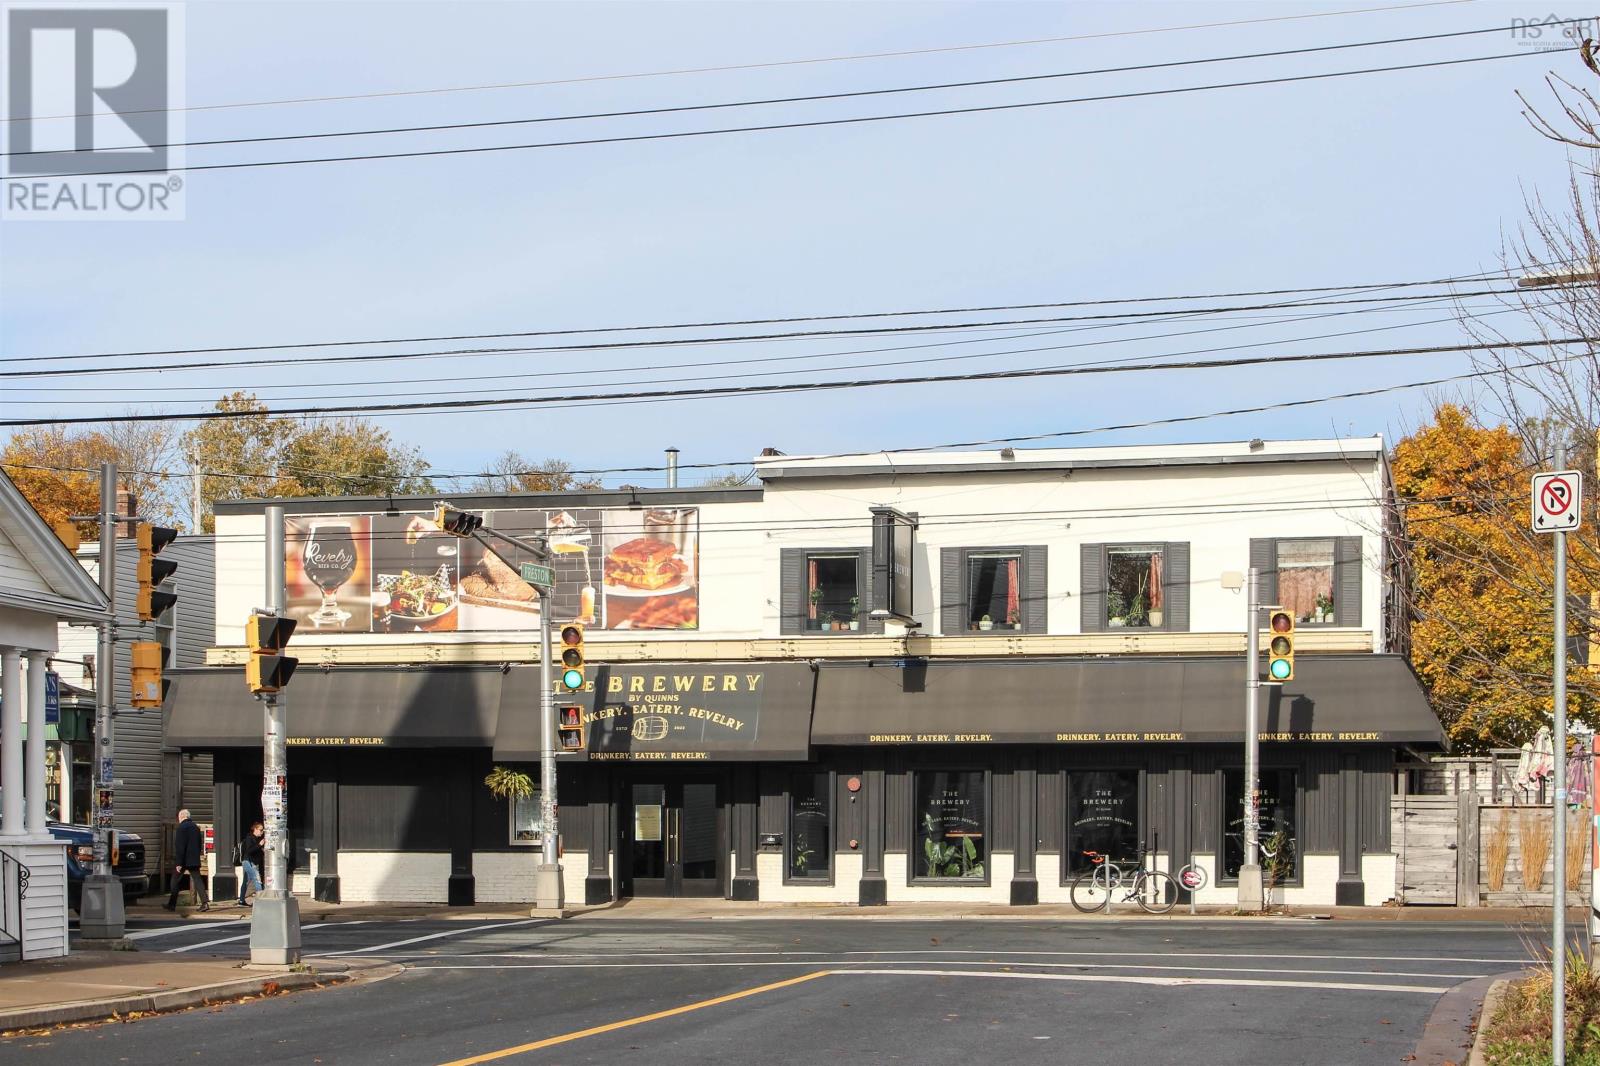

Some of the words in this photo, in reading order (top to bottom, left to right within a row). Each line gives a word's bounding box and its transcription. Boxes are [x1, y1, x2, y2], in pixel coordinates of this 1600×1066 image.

[306, 542, 353, 570] Revelry
[524, 566, 550, 583] PRESTON
[552, 680, 595, 694] TE
[607, 674, 761, 693] BREWERY
[628, 694, 641, 703] BY
[644, 694, 680, 704] QUINNS
[583, 706, 627, 723] NKERY.
[633, 704, 684, 716] EATERY.
[688, 707, 745, 731] REVELRY
[917, 734, 950, 742] EATERY.
[954, 734, 993, 742] REVELRY.
[1056, 733, 1101, 741] DRINKERY.
[1105, 733, 1140, 741] EATERY.
[1143, 733, 1183, 741] REVELRY.
[1299, 732, 1335, 740] EATERY.
[1339, 732, 1379, 740] REVELRY.
[286, 737, 312, 745] NKERY.
[315, 737, 346, 745] EATERY.
[349, 737, 384, 745] REVELRY.
[590, 752, 631, 760] DRINKERY.
[635, 752, 667, 760] EATERY.
[671, 752, 707, 760] REVELRY.
